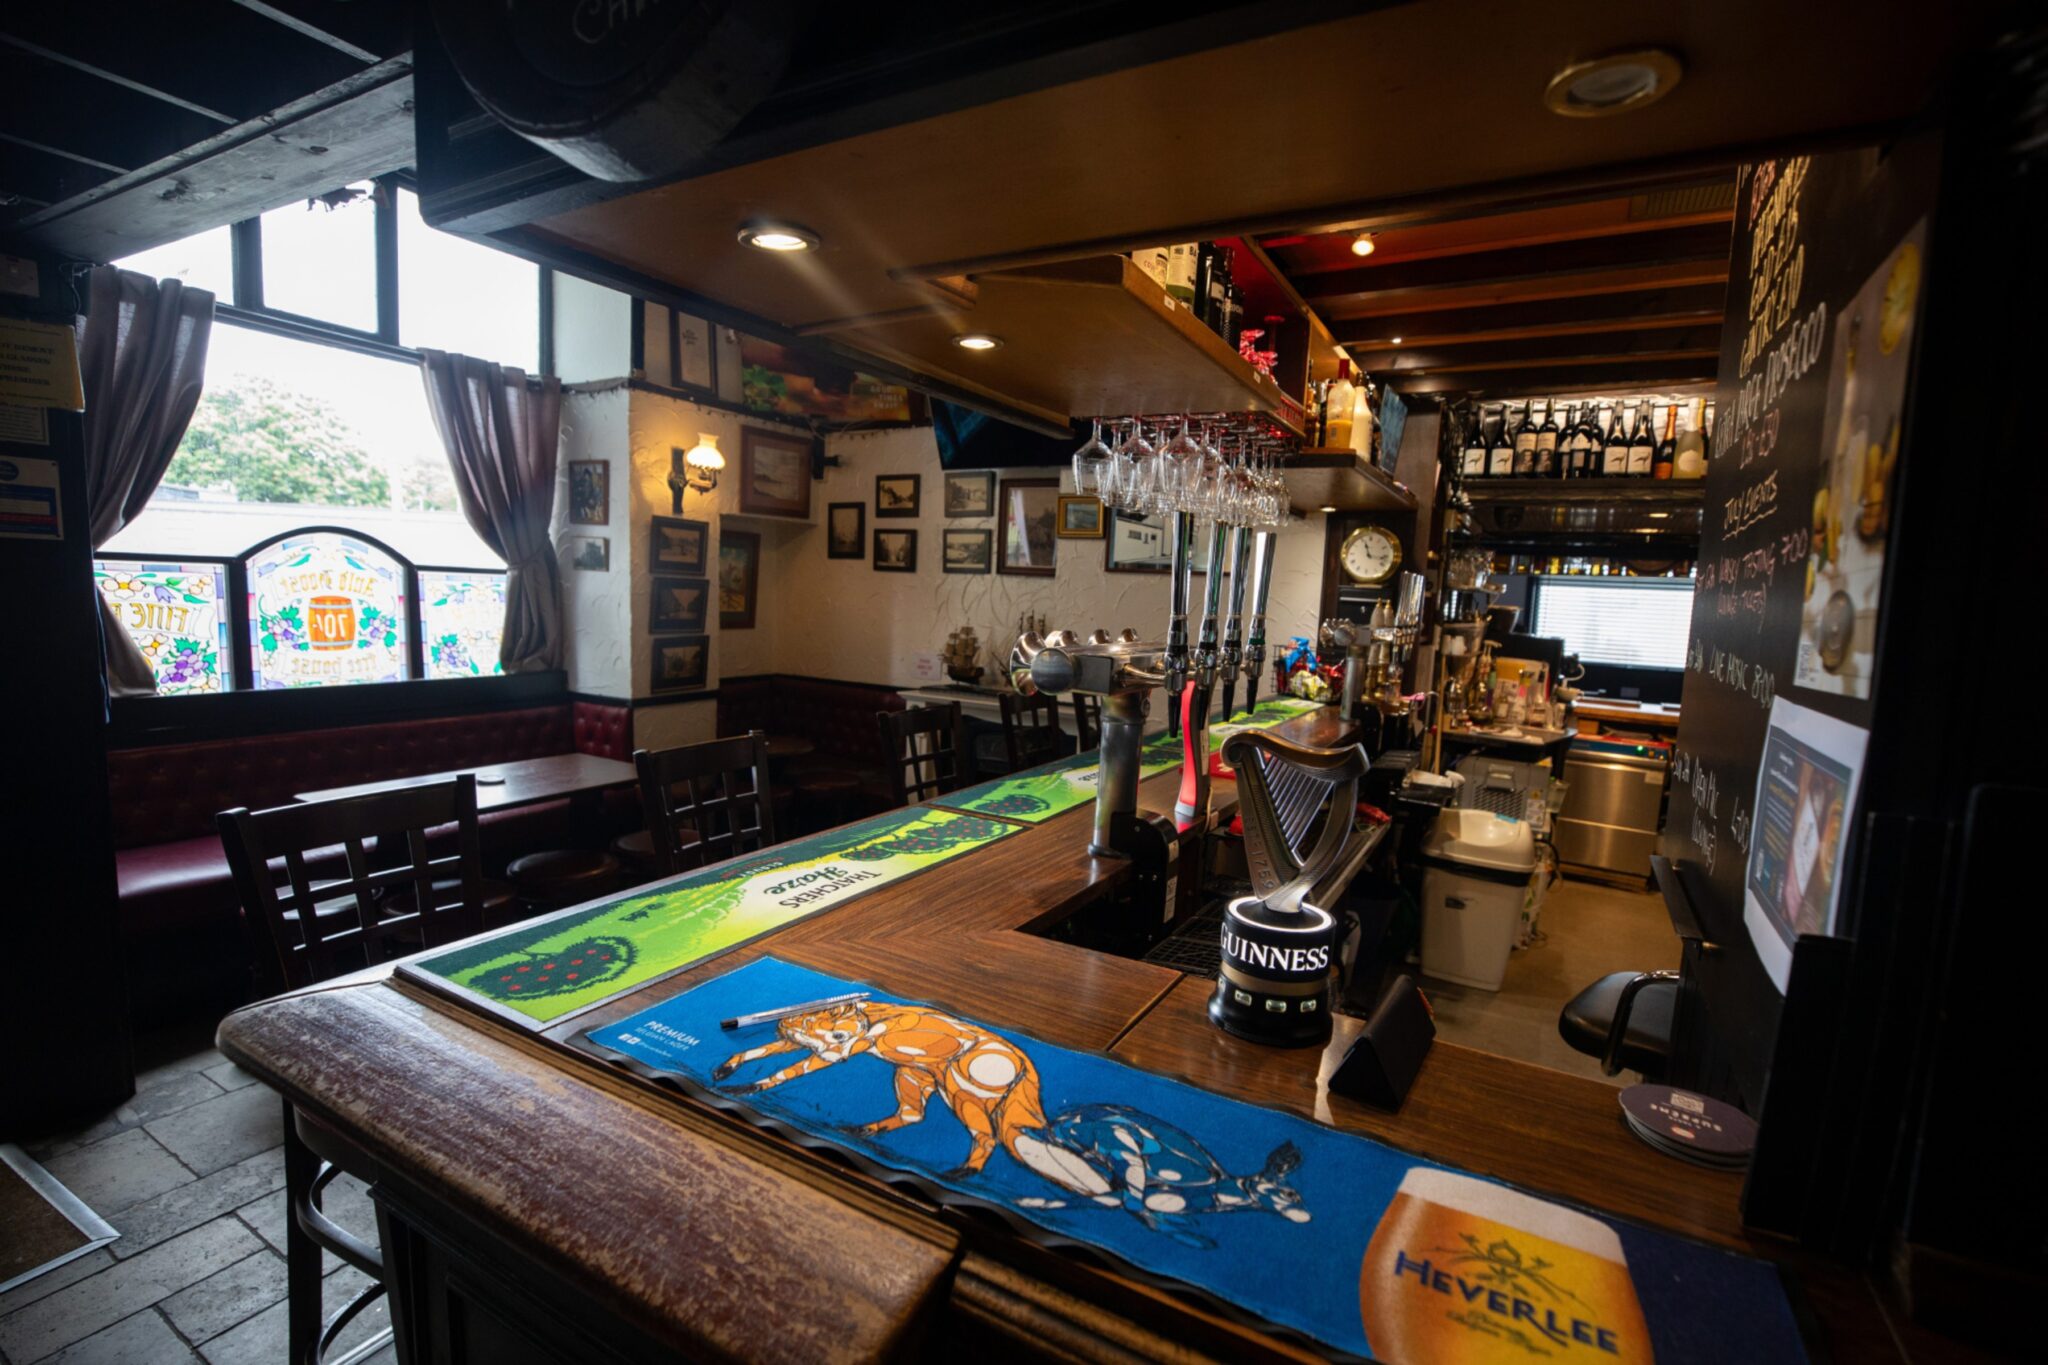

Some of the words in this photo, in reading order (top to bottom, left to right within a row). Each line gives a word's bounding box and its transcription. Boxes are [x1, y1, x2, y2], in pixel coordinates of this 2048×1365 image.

[763, 866, 849, 896] Haze
[778, 870, 882, 910] THATCHERS
[1220, 921, 1330, 973] GUINNESS
[643, 1019, 701, 1047] PREMIUM
[1393, 1249, 1621, 1356] HEVERLEE
